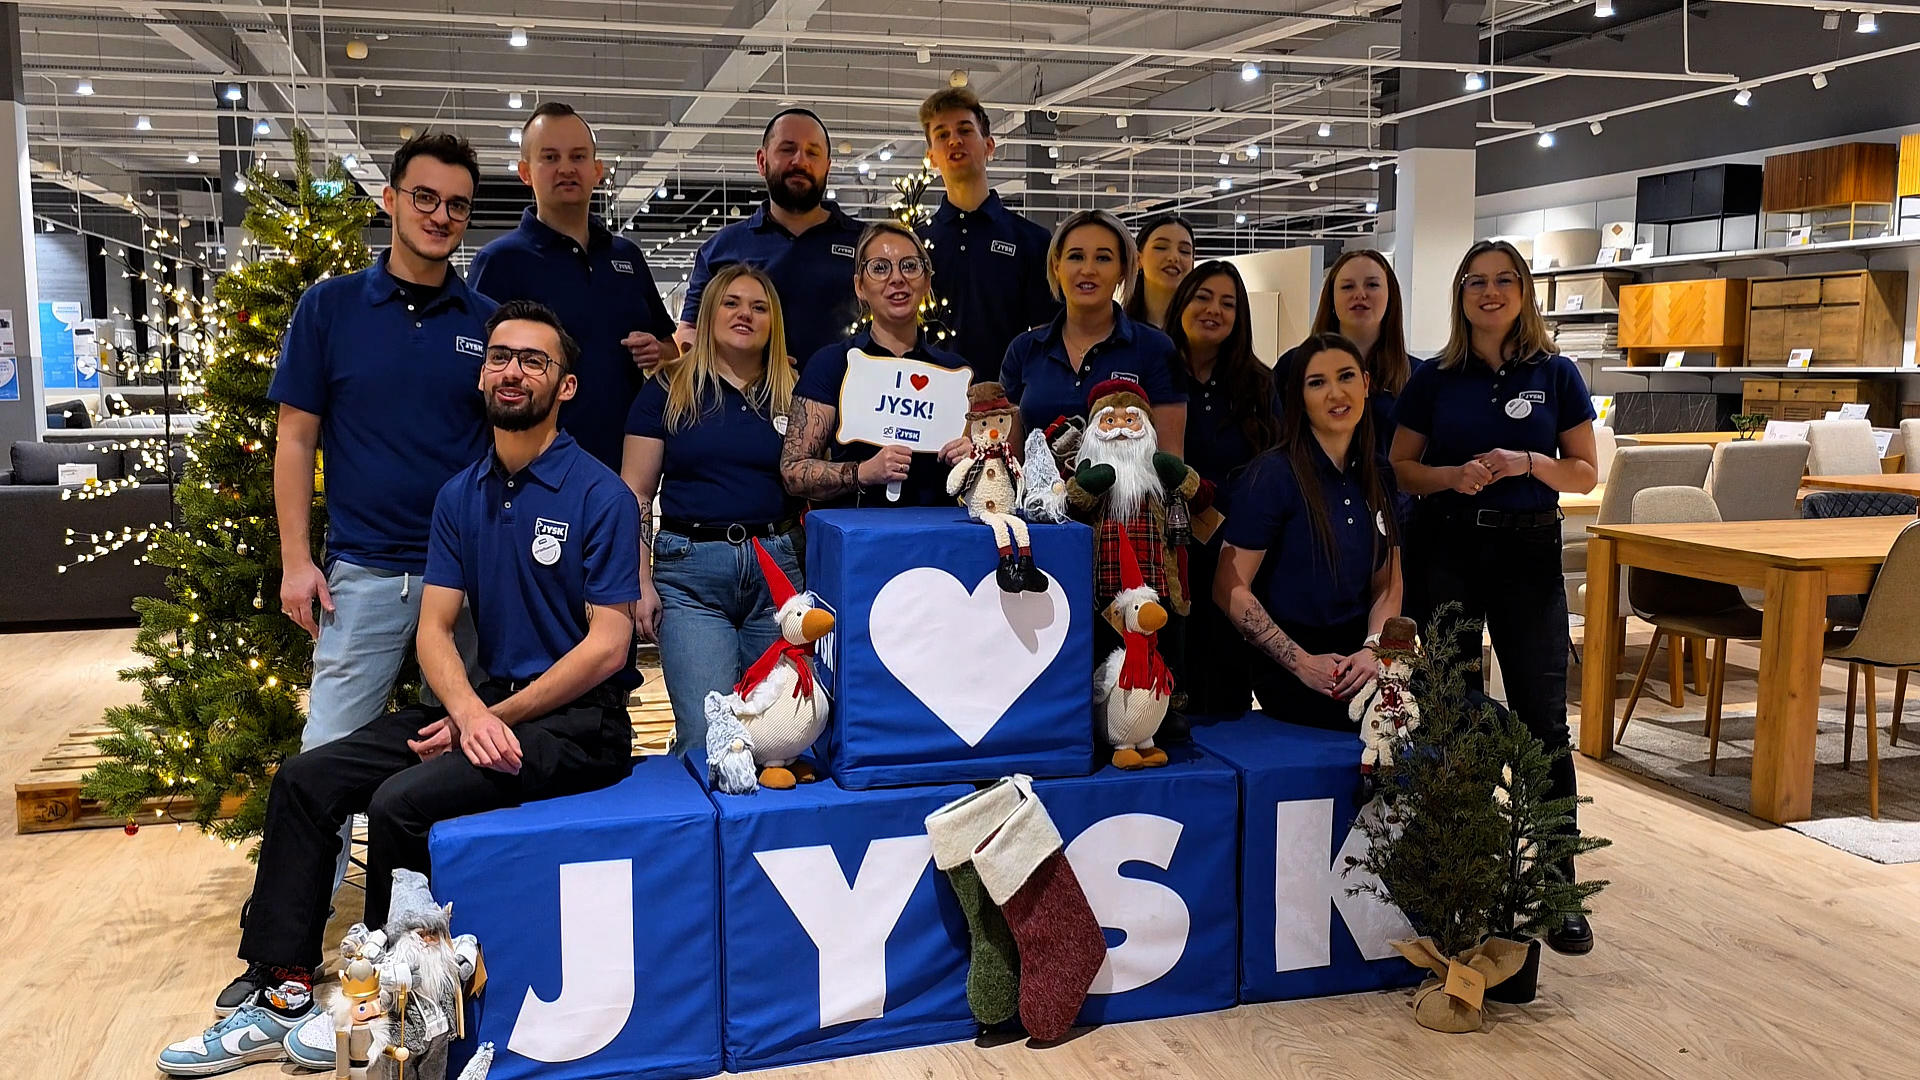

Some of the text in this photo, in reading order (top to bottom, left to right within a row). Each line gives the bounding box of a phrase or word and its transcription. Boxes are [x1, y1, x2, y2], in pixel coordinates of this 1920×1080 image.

[996, 244, 1014, 253] JYSK
[895, 371, 902, 389] I
[874, 394, 935, 420] JYSK!
[900, 430, 919, 440] JYSK
[541, 524, 565, 537] JYSK
[507, 797, 1421, 1063] JYSK
